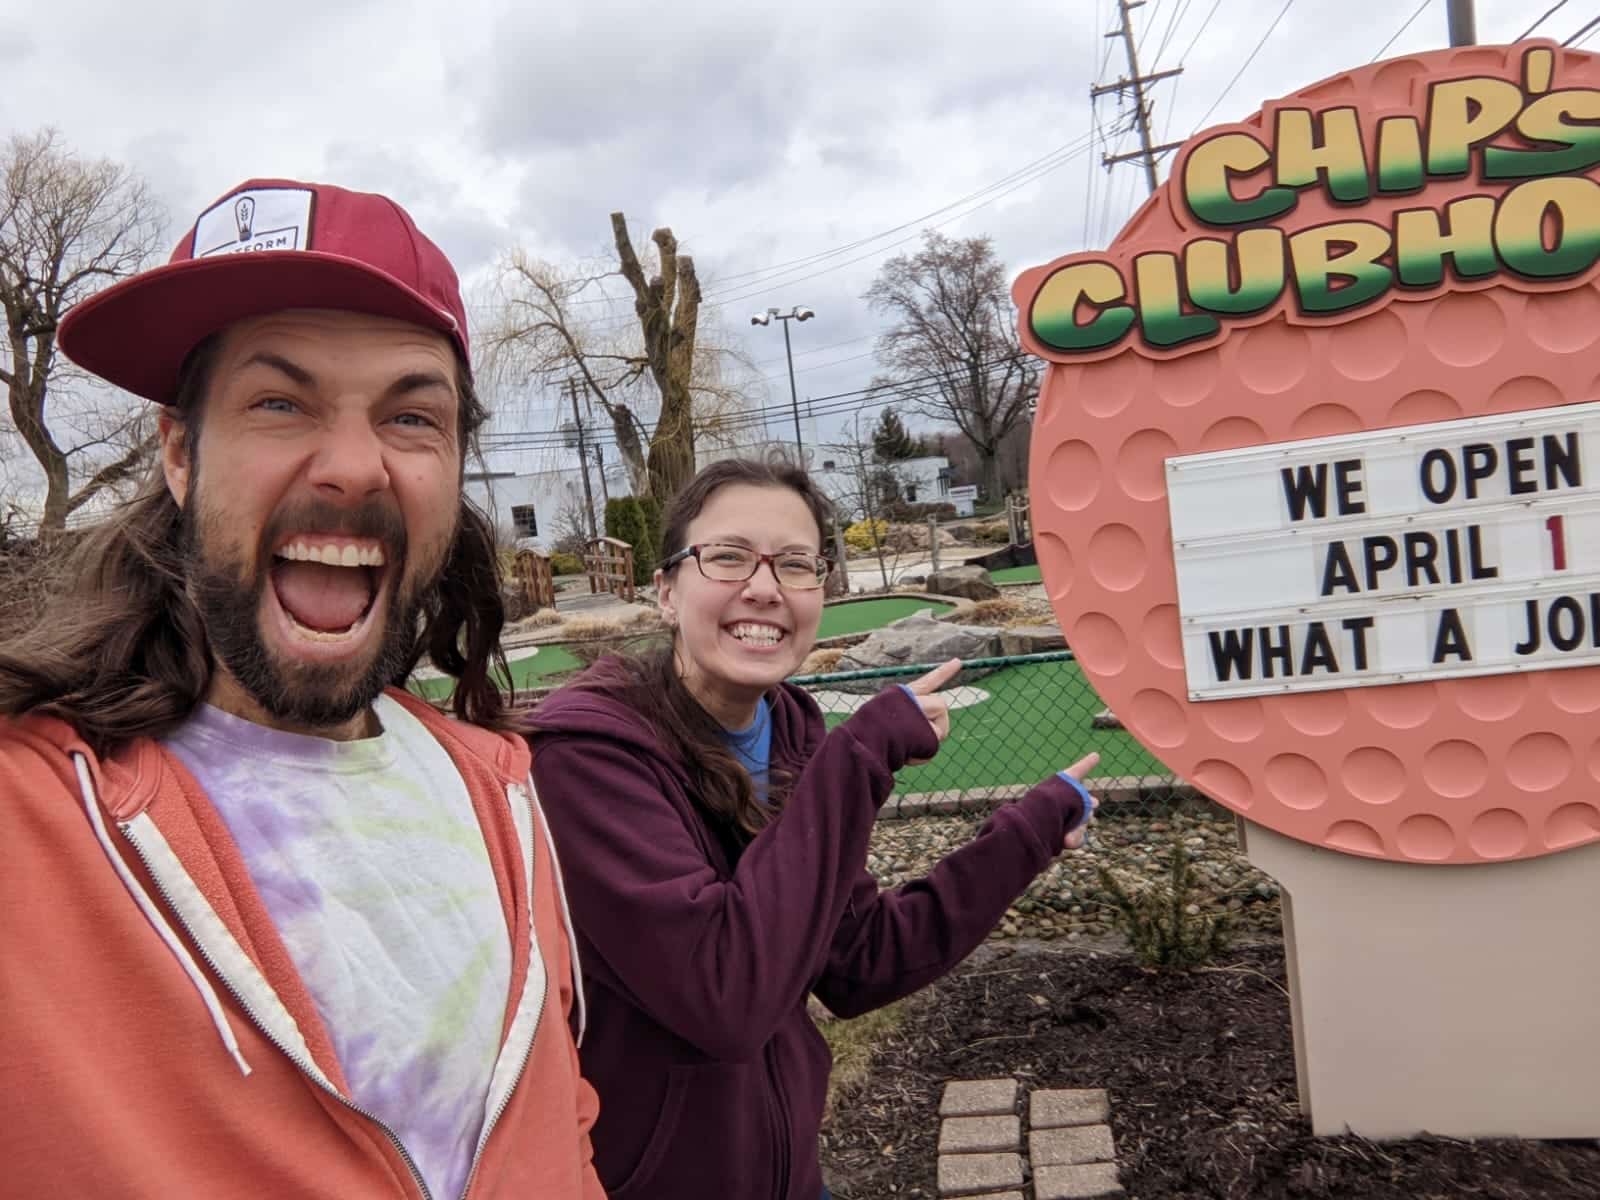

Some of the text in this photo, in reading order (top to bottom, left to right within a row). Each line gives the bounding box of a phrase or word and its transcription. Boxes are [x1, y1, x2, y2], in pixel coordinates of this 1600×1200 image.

[1182, 46, 1600, 226] CHIP'S
[235, 236, 287, 252] FORM
[1030, 176, 1600, 351] CLUBHO
[1281, 432, 1582, 521] WE OPEN
[1321, 514, 1567, 596] APRIL 1
[1208, 616, 1374, 682] WHAT
[1432, 608, 1472, 664] A
